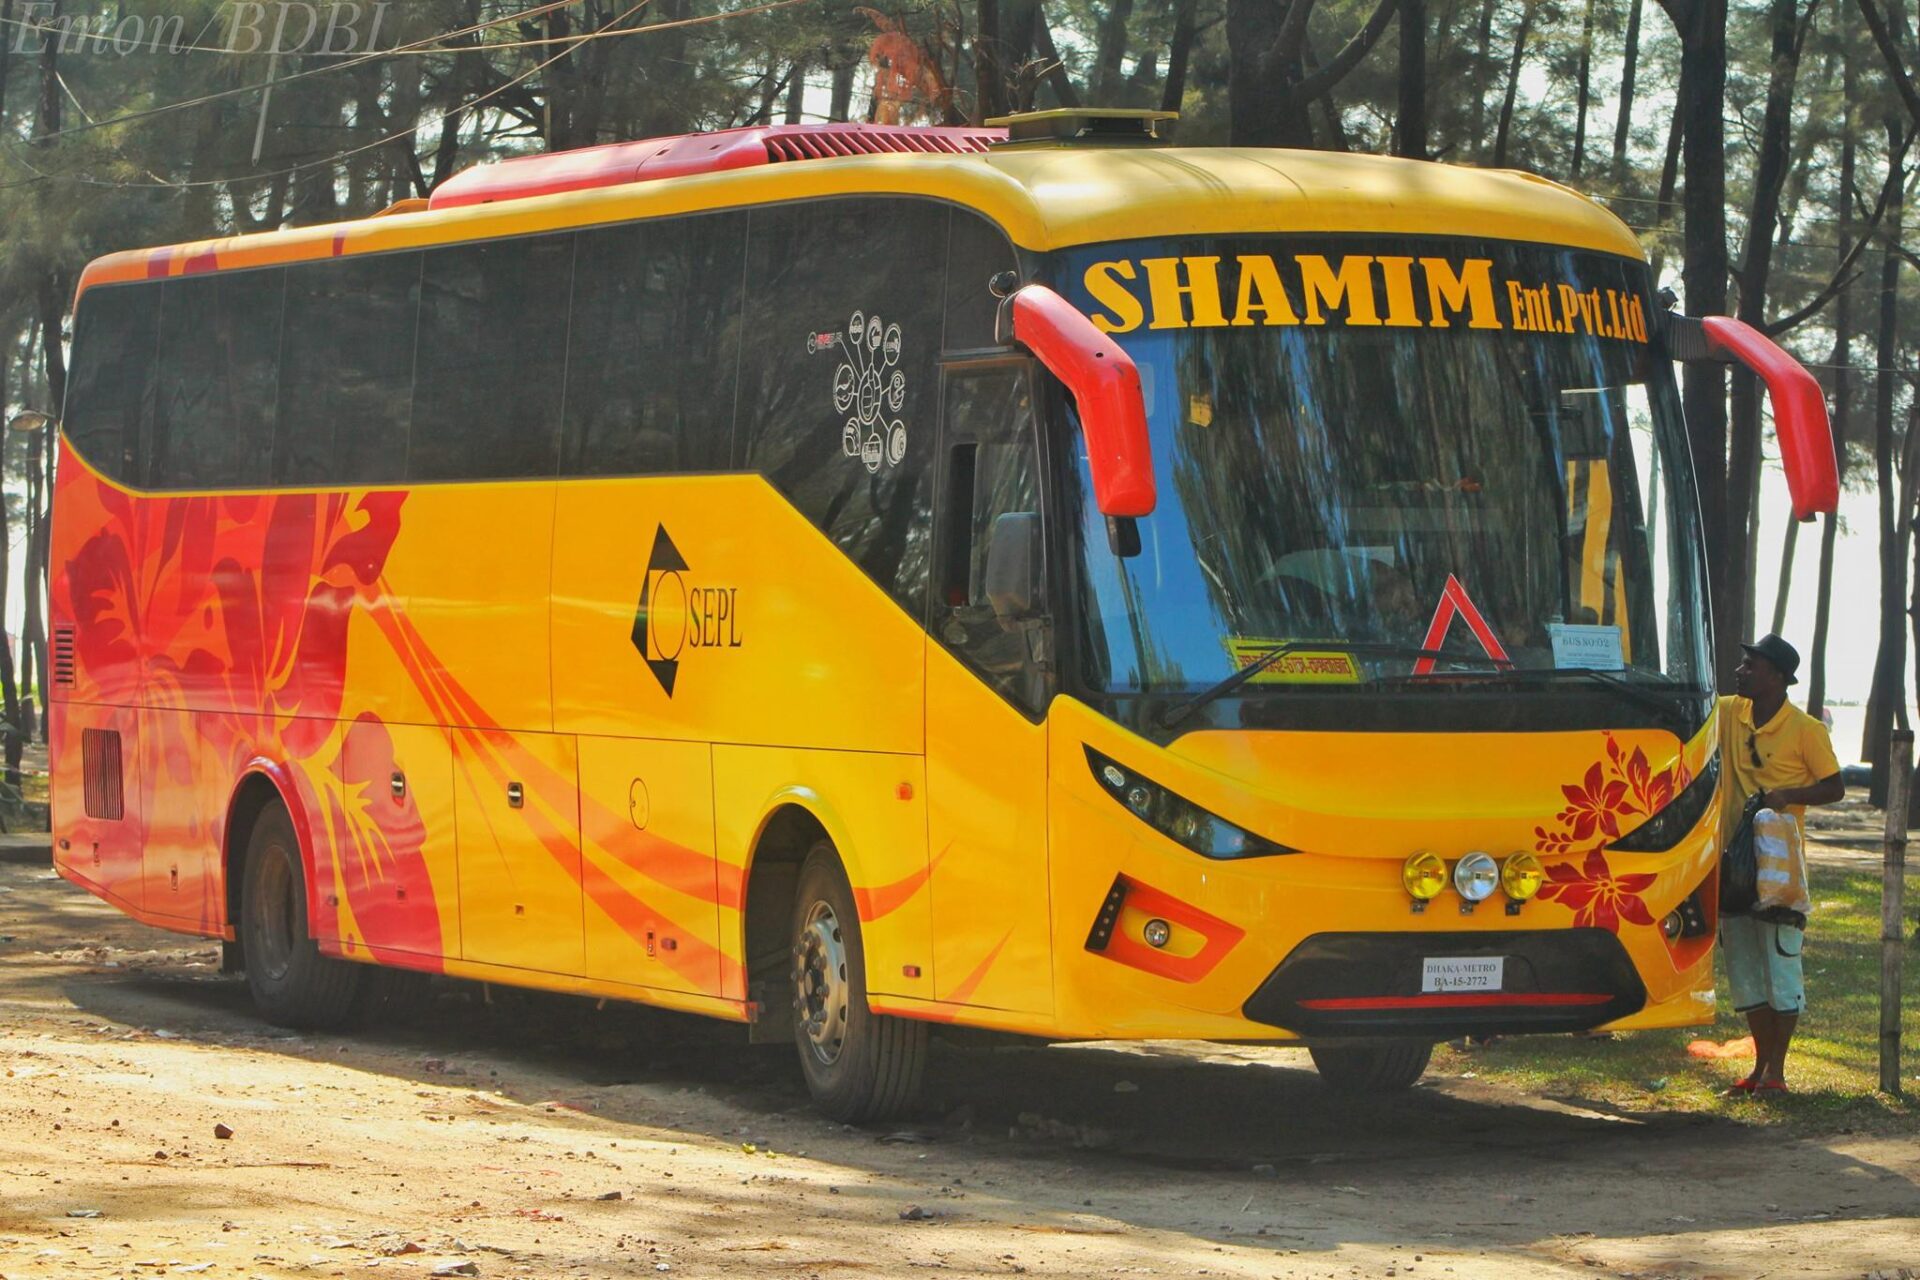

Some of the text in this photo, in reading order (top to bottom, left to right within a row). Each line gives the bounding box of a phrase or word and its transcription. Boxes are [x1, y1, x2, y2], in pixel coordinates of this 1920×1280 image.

[1083, 254, 1503, 334] SHAMIM
[690, 587, 743, 648] SEPL
[1427, 964, 1497, 974] DHAKA-METRO
